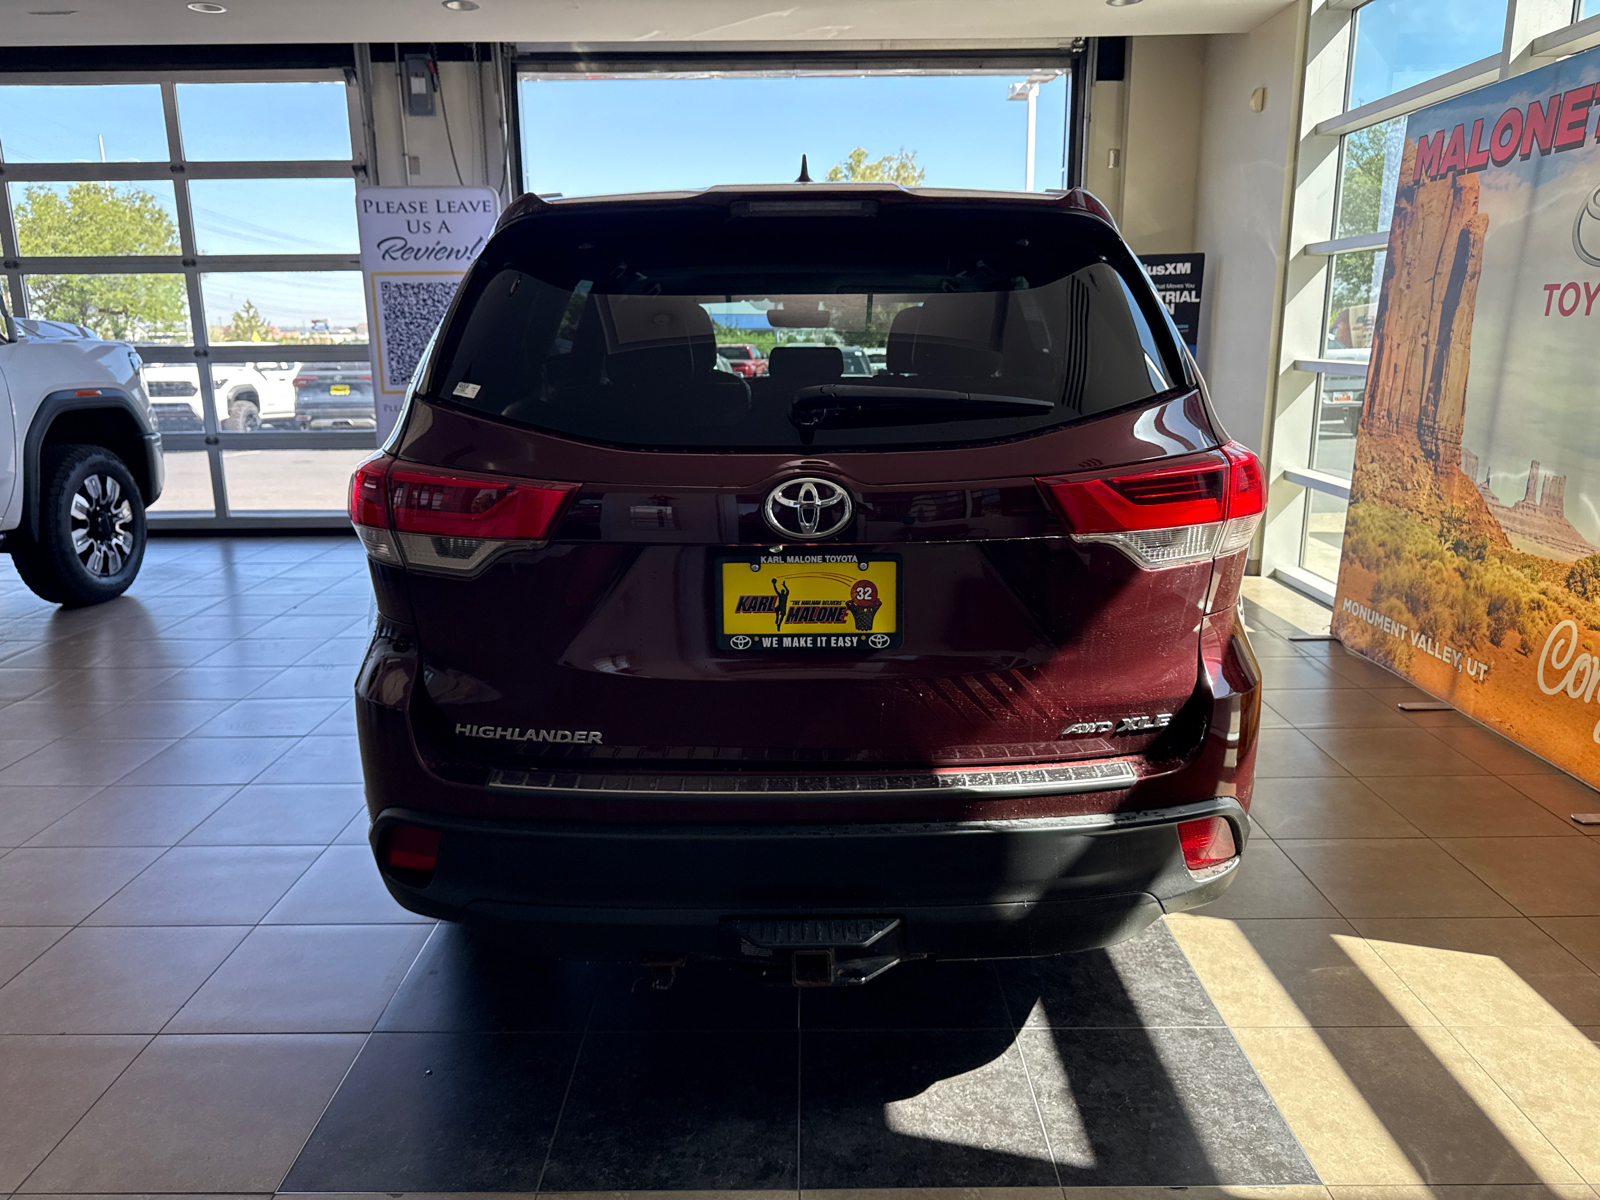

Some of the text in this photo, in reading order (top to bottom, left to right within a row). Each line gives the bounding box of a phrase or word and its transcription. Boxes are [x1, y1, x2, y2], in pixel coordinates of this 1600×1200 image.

[363, 199, 492, 214] PLEASE LEAVE
[406, 220, 452, 234] US A
[376, 236, 483, 262] Review!
[760, 555, 858, 564] KARL MALONE TOYOTA
[856, 587, 872, 600] 32
[735, 595, 779, 614] KARL
[785, 606, 848, 624] MALONE
[762, 636, 858, 648] WE MAKE IT EASY
[1342, 597, 1489, 681] MONUMENT VALLEY, UT
[1062, 713, 1173, 735] AWD XLE
[455, 723, 603, 744] HIGHLANDER
